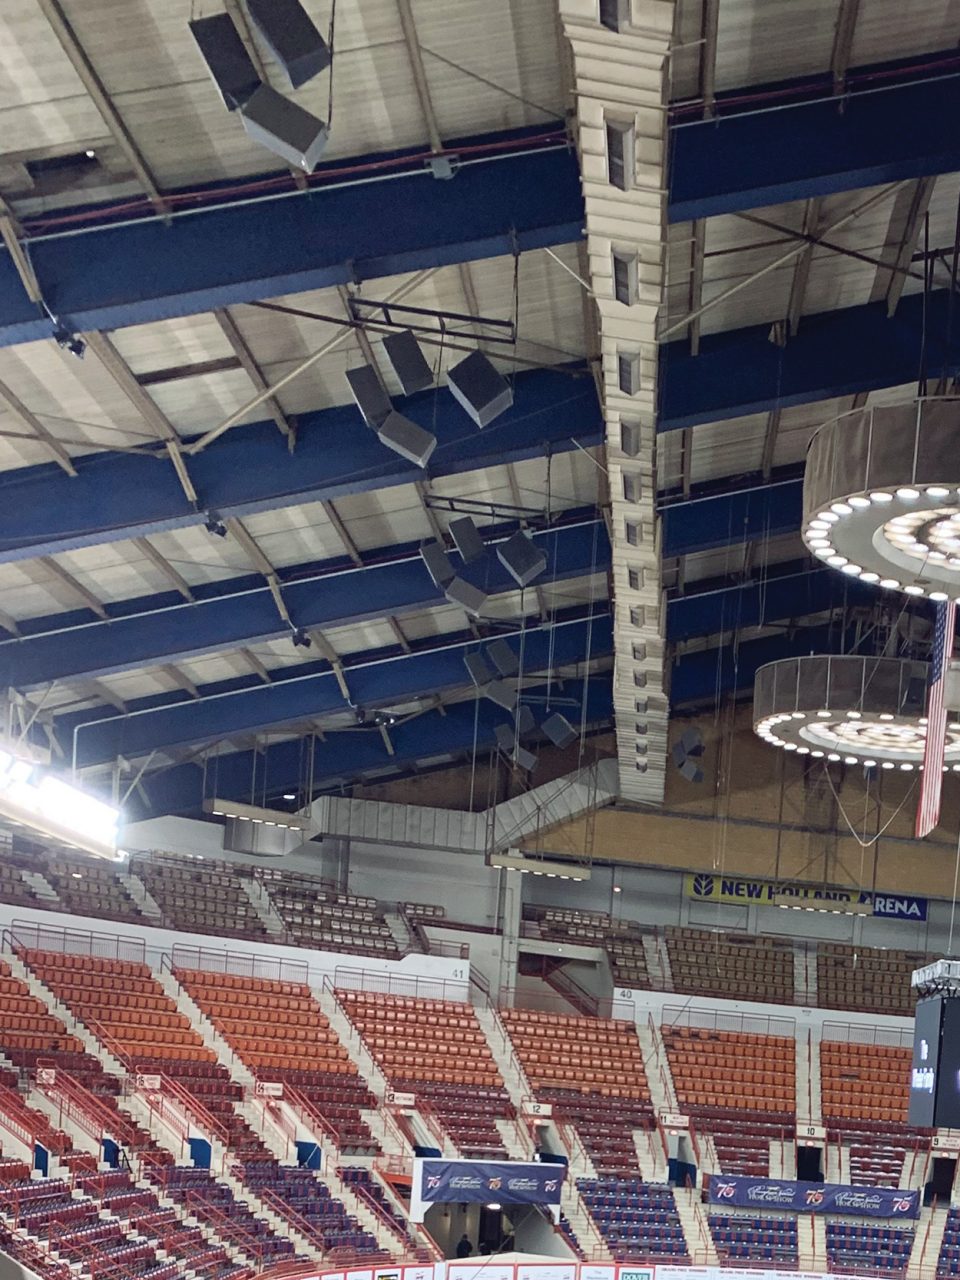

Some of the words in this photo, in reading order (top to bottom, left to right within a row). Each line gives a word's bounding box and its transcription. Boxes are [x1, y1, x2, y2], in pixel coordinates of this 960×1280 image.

[721, 880, 763, 900] NEW
[620, 990, 632, 999] 40
[806, 1126, 815, 1136] 10
[716, 1182, 736, 1198] 75
[805, 1188, 826, 1205] 75
[892, 1197, 912, 1212] 75
